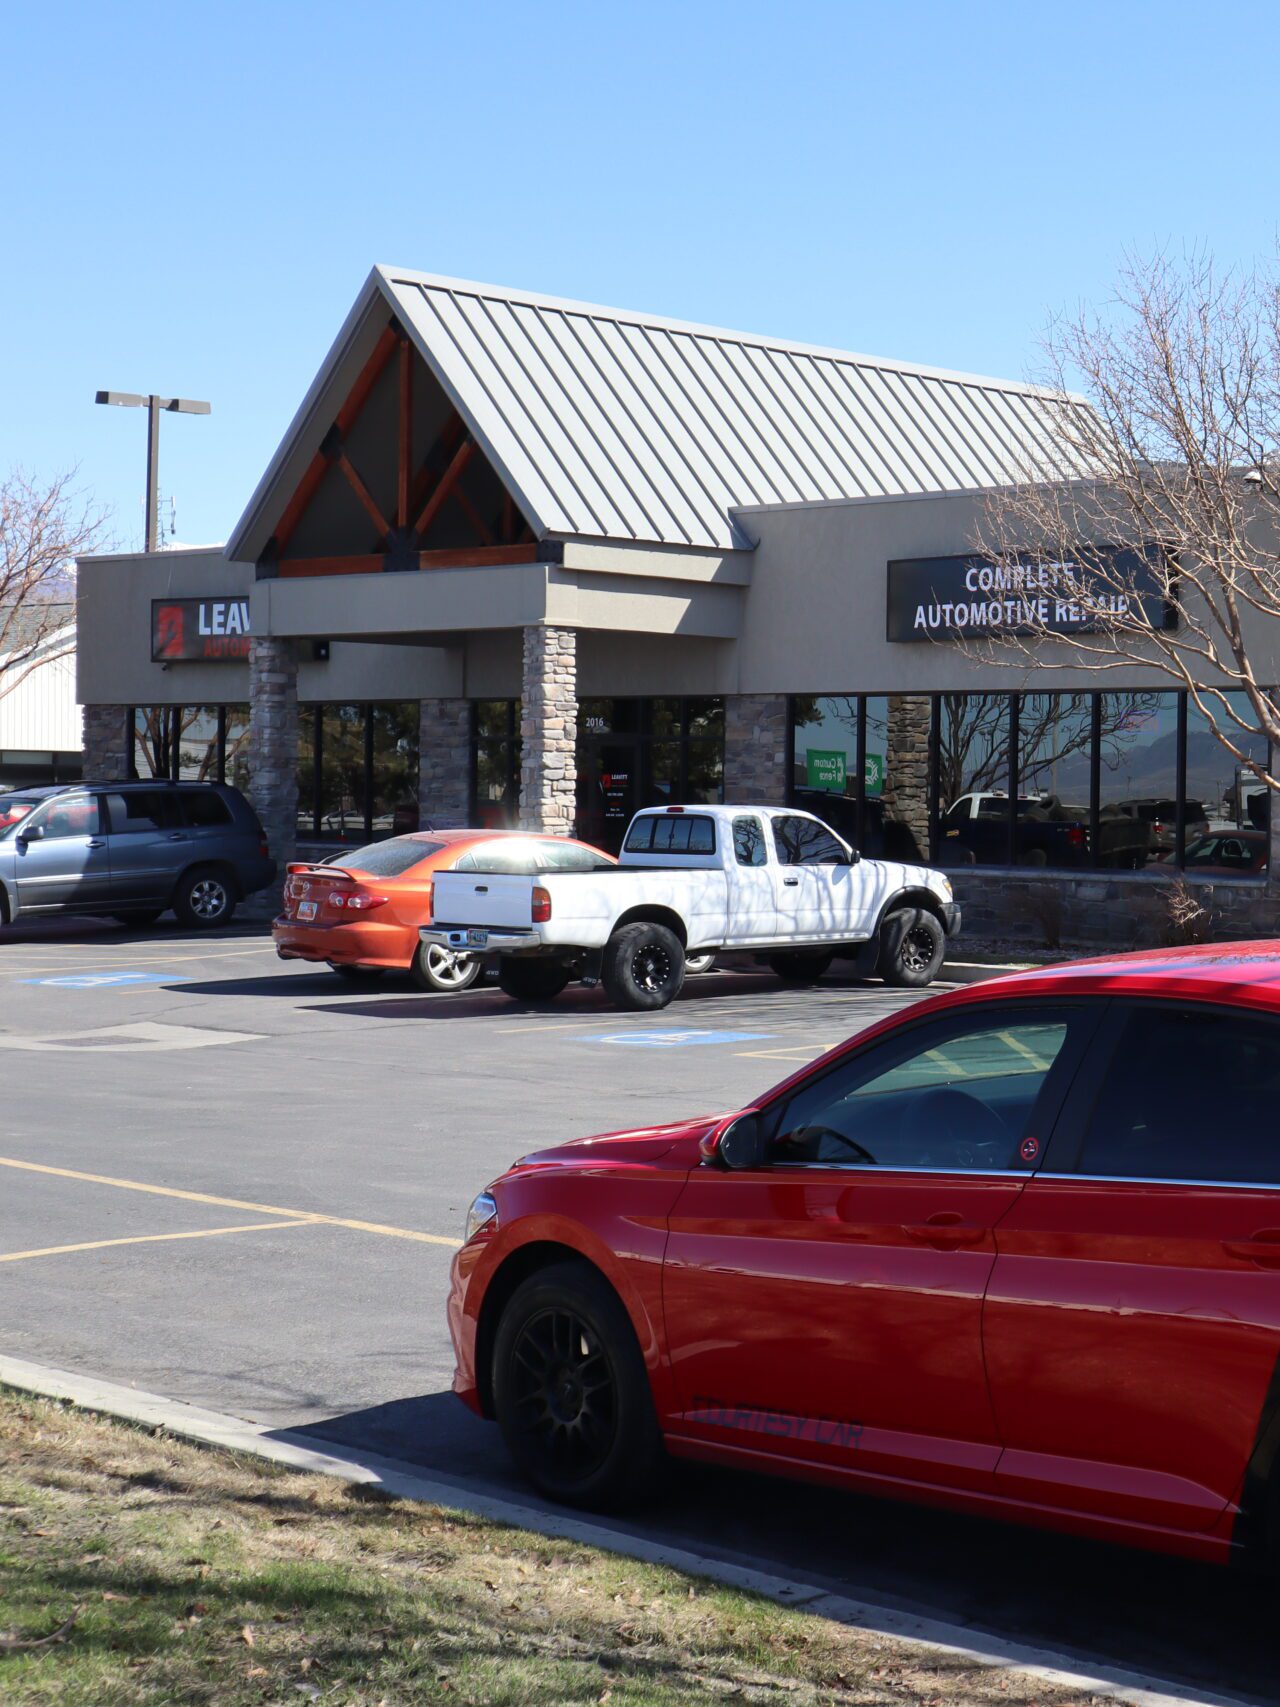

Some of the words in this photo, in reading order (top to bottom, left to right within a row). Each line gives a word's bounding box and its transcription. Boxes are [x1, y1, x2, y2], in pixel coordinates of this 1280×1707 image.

[965, 562, 1074, 592] COMPLETE
[914, 599, 1048, 629] AUTOMOTIVE
[585, 717, 604, 727] 2016
[815, 1414, 864, 1451] CAR
